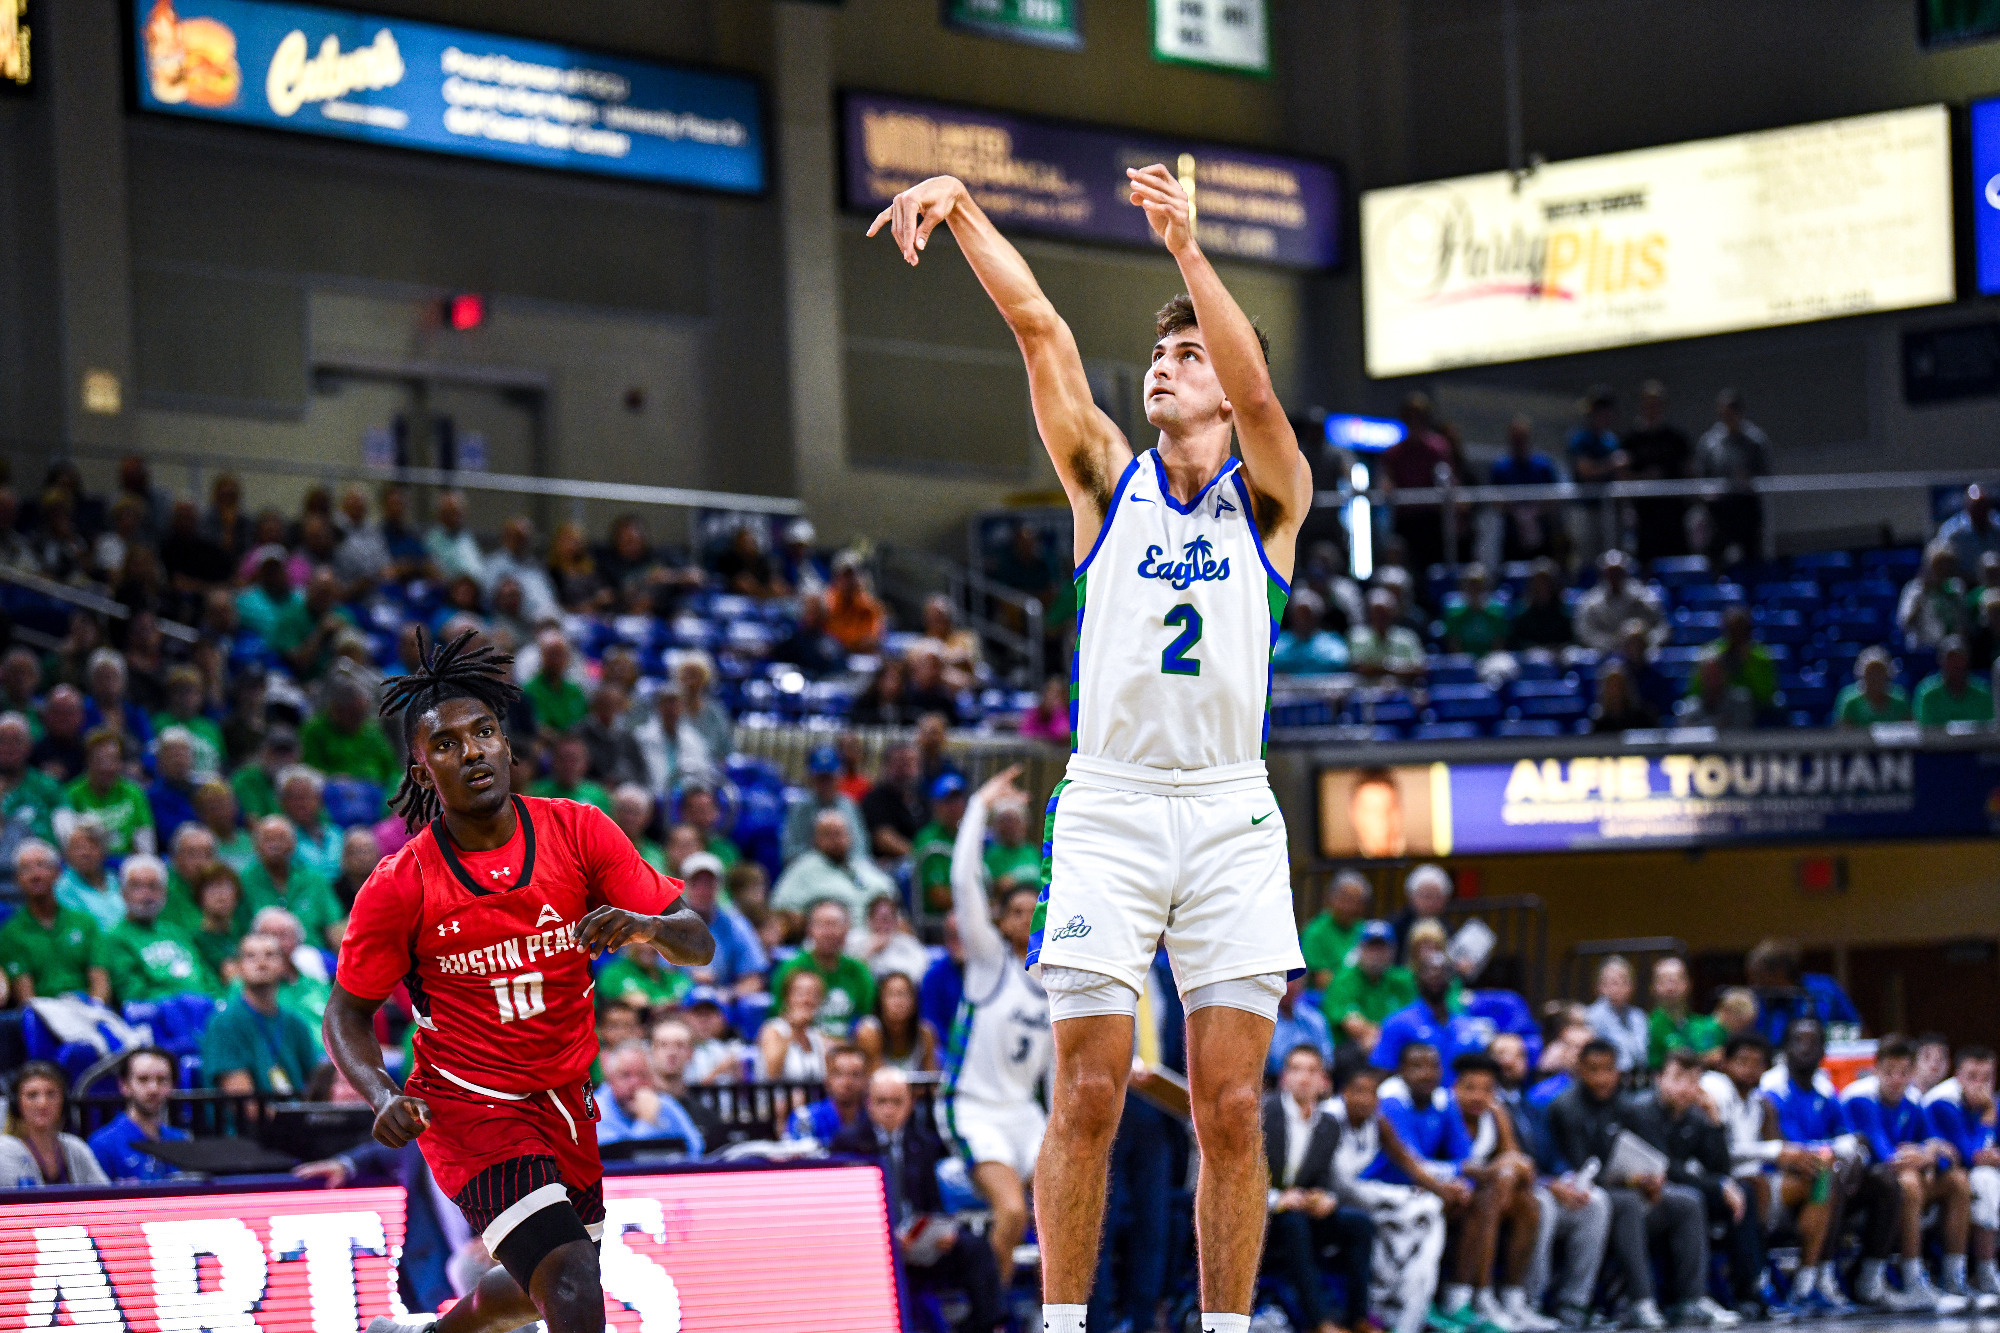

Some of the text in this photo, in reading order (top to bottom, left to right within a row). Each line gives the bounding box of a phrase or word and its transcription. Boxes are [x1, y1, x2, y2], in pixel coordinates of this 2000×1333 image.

[1137, 534, 1231, 591] Eagles
[1161, 602, 1204, 677] 2
[1503, 752, 1915, 801] ALFIE TOUNJIAN
[436, 937, 524, 976] AUSTIN
[489, 971, 547, 1025] 10
